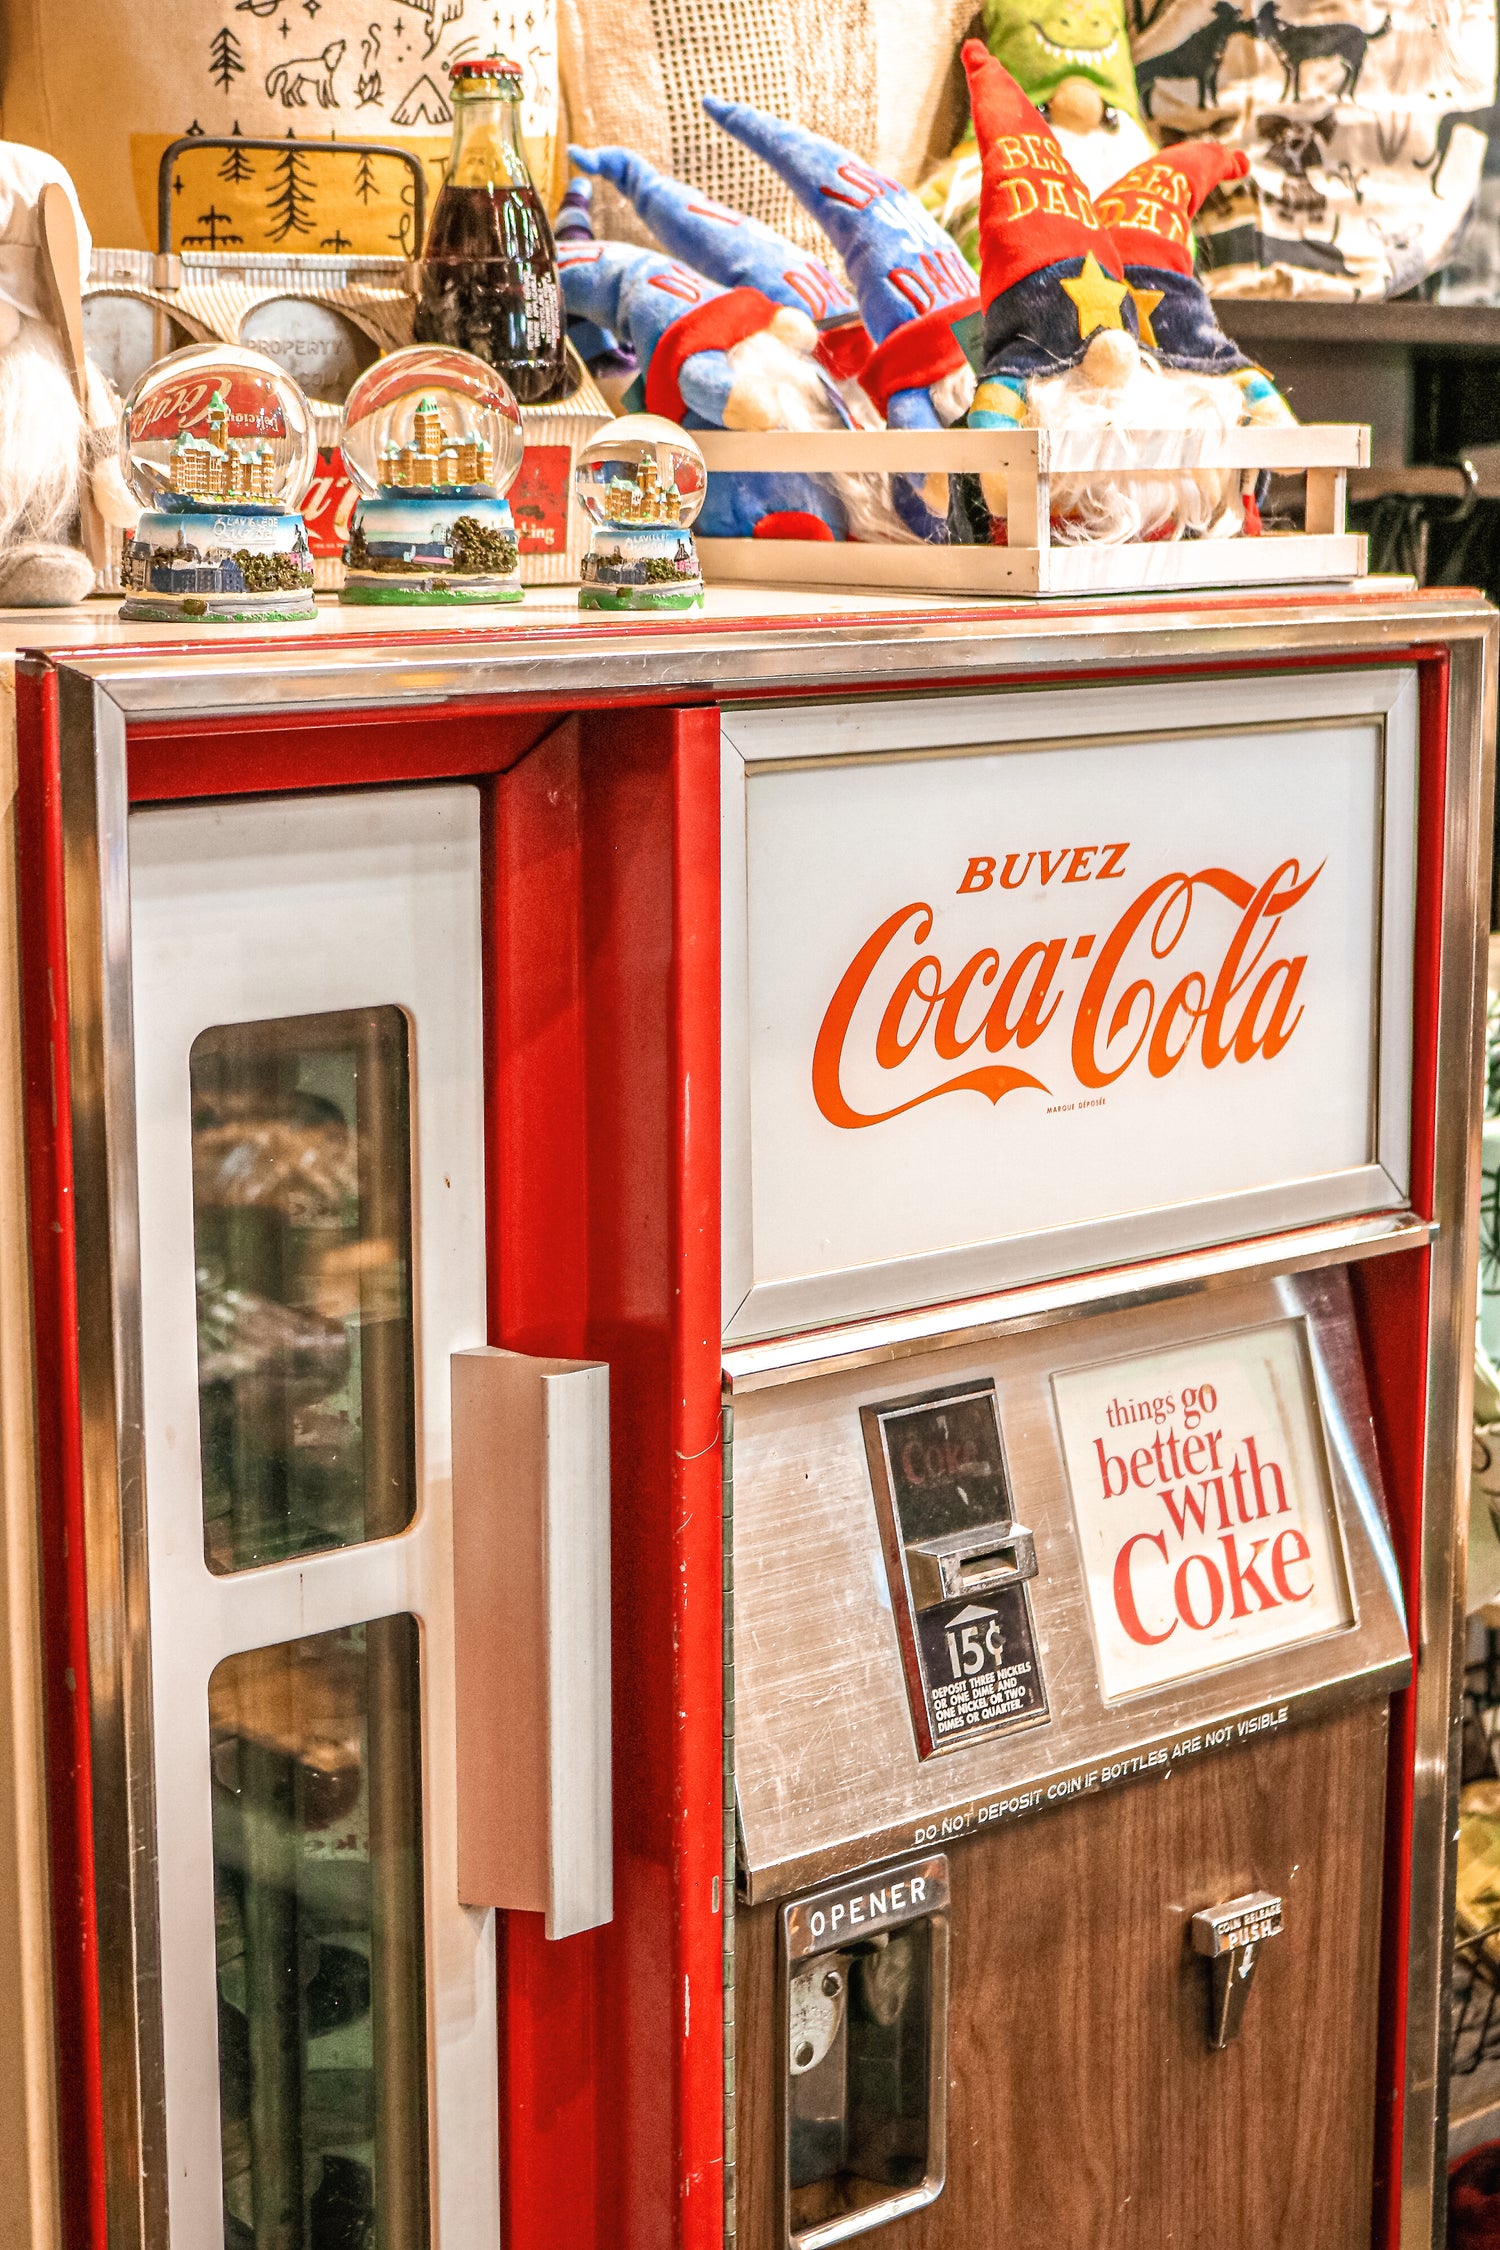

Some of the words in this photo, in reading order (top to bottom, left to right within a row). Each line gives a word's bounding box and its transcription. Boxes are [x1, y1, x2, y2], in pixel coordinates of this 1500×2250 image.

[996, 134, 1068, 176] BES
[956, 842, 1131, 894] BUVEZ
[812, 855, 1327, 1129] Coca-Cola
[1047, 1103, 1074, 1114] MARQUE
[1106, 1395, 1175, 1427] things
[1181, 1384, 1217, 1430] go
[1093, 1427, 1223, 1500] better
[1157, 1435, 1292, 1541] with
[1113, 1528, 1314, 1645] Coke
[945, 1620, 1003, 1679] 15¢
[932, 1680, 968, 1700] DEPOSIT
[969, 1672, 996, 1689] THREE
[997, 1661, 1032, 1677] NICKELS
[934, 1698, 948, 1711] OR
[950, 1692, 970, 1706] ONE
[972, 1684, 995, 1699] DIME
[997, 1677, 1017, 1692] AND
[935, 1708, 957, 1722] ONE
[958, 1699, 989, 1715] NICKEL
[990, 1693, 1003, 1706] OR
[1004, 1686, 1026, 1700] TWO
[938, 1717, 965, 1734] DIMES
[966, 1711, 980, 1725] OR
[914, 1825, 937, 1845] DO
[941, 1811, 974, 1836] NOT
[978, 1788, 1042, 1824] DEPOSIT
[1047, 1778, 1082, 1800] COIN
[1084, 1770, 1099, 1788] IF
[1101, 1747, 1168, 1782] BOTTLES
[1171, 1736, 1202, 1759] ARE
[1205, 1725, 1234, 1748] NOT
[1237, 1706, 1289, 1737] VISIBLE
[810, 1877, 926, 1936] OPENER
[1218, 1918, 1242, 1935] COIN
[1244, 1903, 1282, 1925] RELEASE
[1228, 1919, 1272, 1951] PUSH
